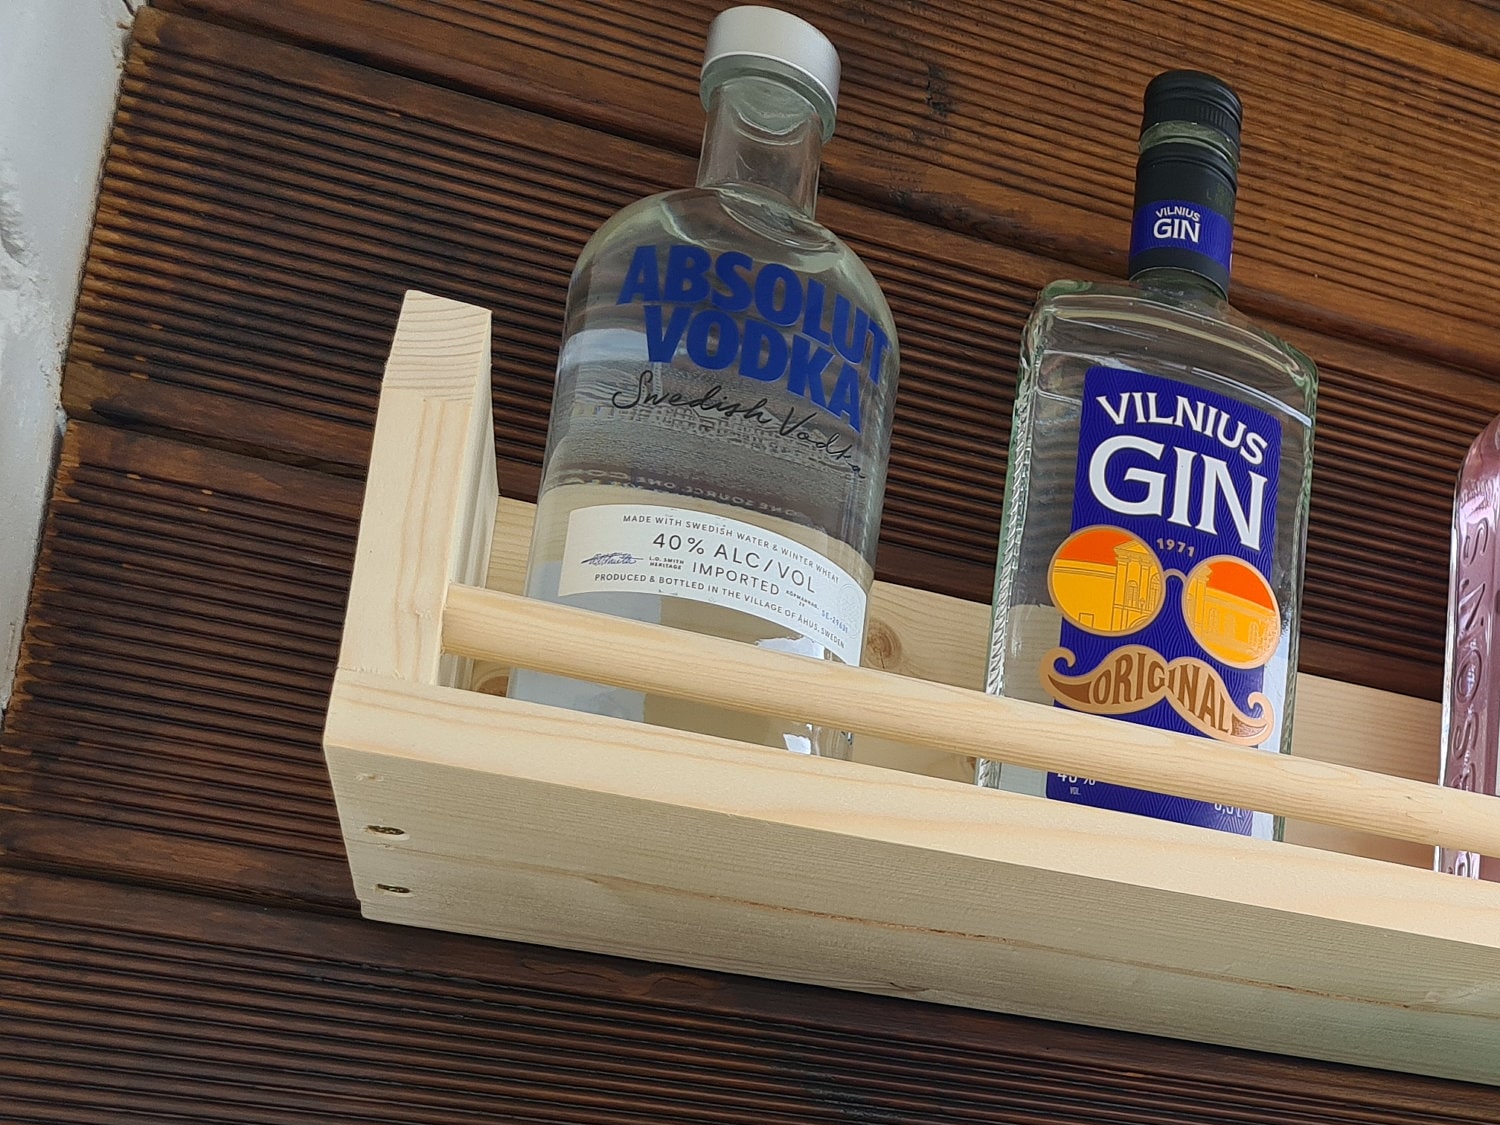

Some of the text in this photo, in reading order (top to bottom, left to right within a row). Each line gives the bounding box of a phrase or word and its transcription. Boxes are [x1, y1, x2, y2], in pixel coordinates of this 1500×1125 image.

[1153, 218, 1201, 243] GIN
[1155, 205, 1201, 223] VILNIUS
[616, 244, 889, 385] ABSOLUT
[611, 370, 773, 424] Swedish
[643, 304, 861, 434] VODKA
[1096, 391, 1268, 466] VILNIUS
[1088, 434, 1268, 551] GIN
[623, 515, 652, 523] MADE
[655, 516, 682, 527] WITH
[686, 520, 733, 537] SWEDISH
[736, 531, 770, 549] WATER
[781, 547, 815, 568] WINTER
[816, 563, 840, 585] WHEAT
[652, 533, 816, 594] 40% ALC/VOL
[1156, 537, 1196, 558] 1971
[594, 573, 647, 582] PRODUCED
[658, 577, 705, 590] BOTTLED
[708, 584, 719, 593] IN
[722, 588, 741, 599] THE
[744, 593, 782, 614] VILLAGE
[785, 609, 796, 619] OF
[692, 561, 780, 596] IMPORTED
[1093, 651, 1231, 735] ORIGINAL
